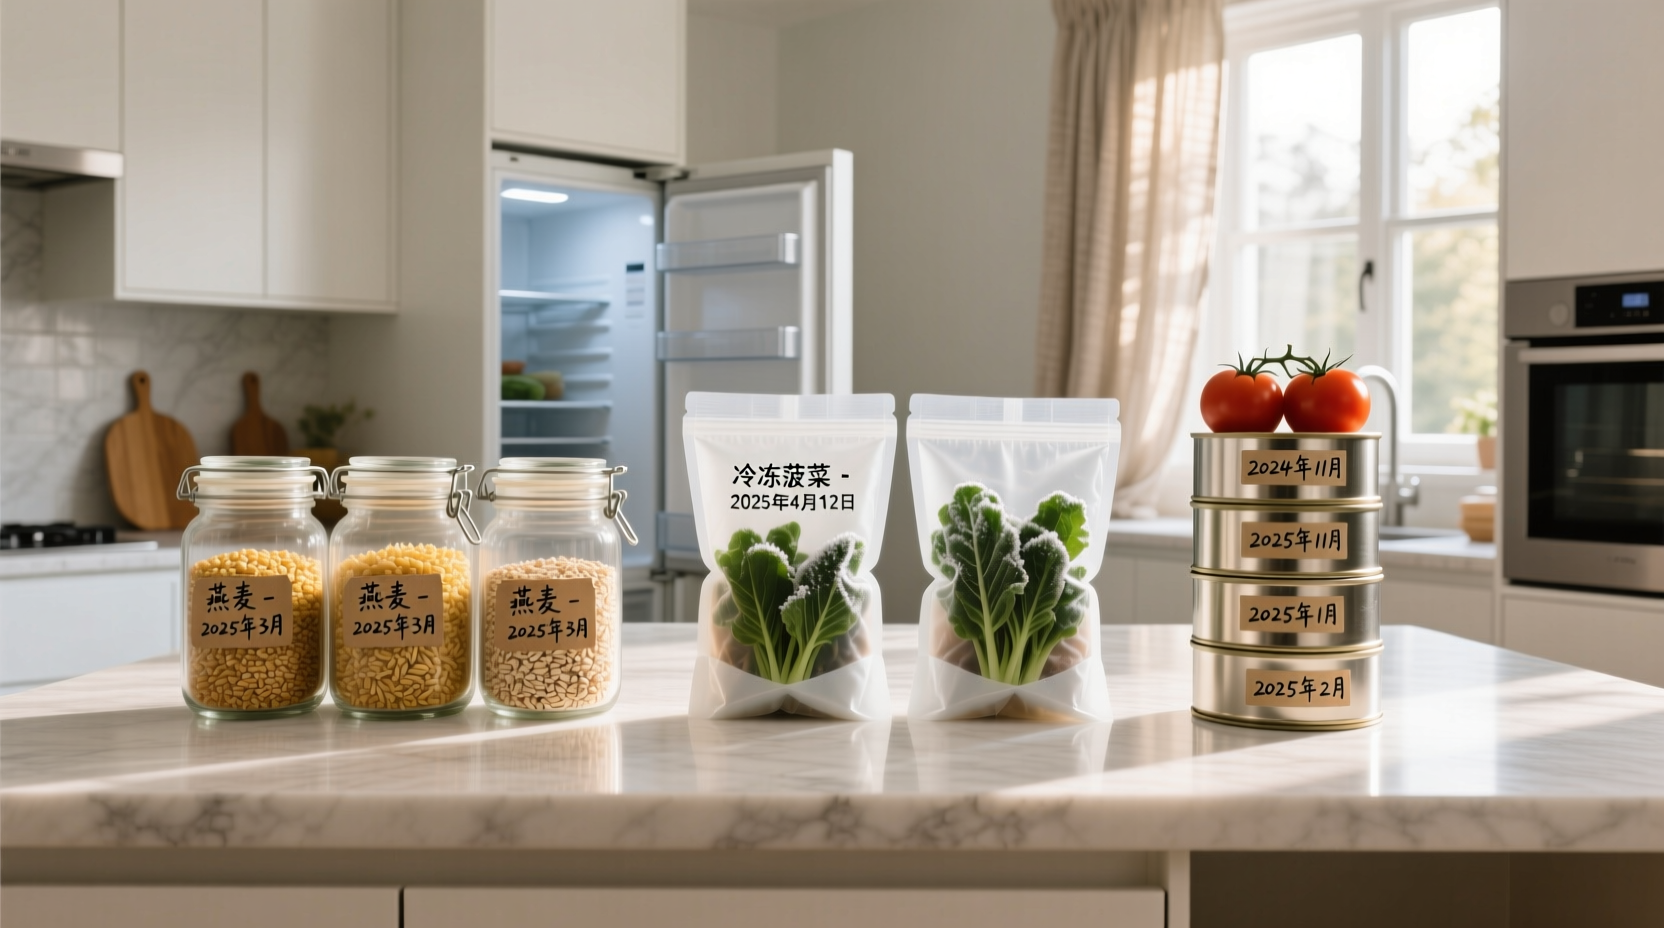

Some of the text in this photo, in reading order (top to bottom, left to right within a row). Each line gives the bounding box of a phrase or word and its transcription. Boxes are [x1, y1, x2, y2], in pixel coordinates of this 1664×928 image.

[732, 462, 831, 488] 冷冻菠菜
[1247, 454, 1341, 481] 2024年11月
[730, 493, 855, 512] 2025年4月12日
[1249, 527, 1341, 553] 2025年11月
[206, 580, 255, 612] 燕麦
[358, 580, 411, 611] 燕麦
[509, 584, 561, 616] 燕麦
[200, 613, 283, 640] 2025年3月
[352, 613, 435, 640] 2025年3月
[1248, 601, 1337, 628] 2025年1月
[507, 617, 588, 643] 2025年3月
[1253, 675, 1344, 702] 2025年2月
